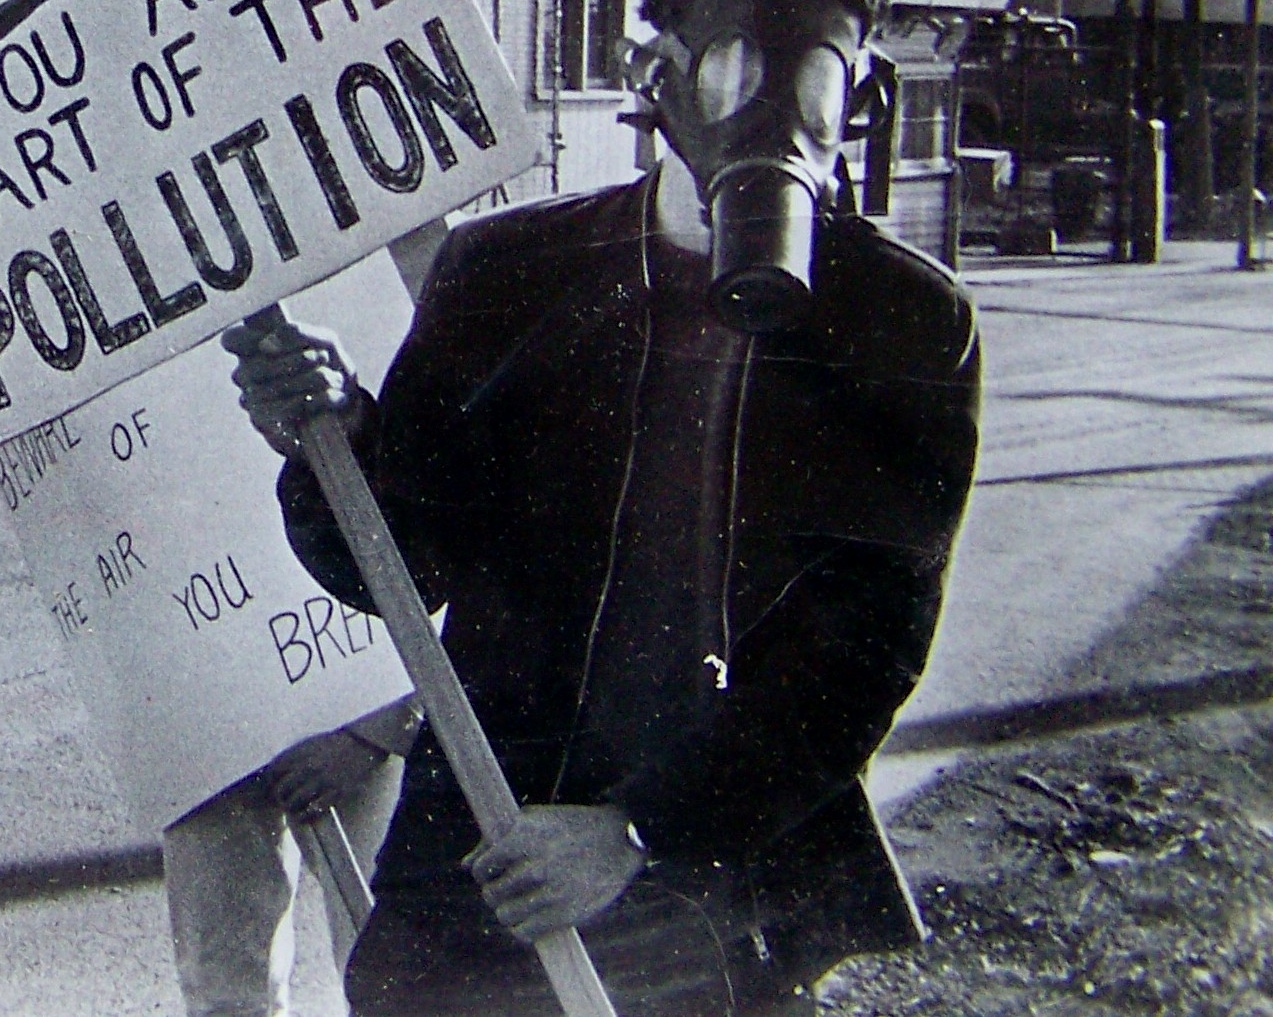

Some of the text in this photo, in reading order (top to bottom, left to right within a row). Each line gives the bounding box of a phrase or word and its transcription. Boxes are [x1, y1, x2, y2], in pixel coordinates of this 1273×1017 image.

[131, 31, 203, 131] OF
[110, 407, 151, 462] OF
[50, 530, 147, 642] THE AIR
[171, 555, 255, 631] YOU
